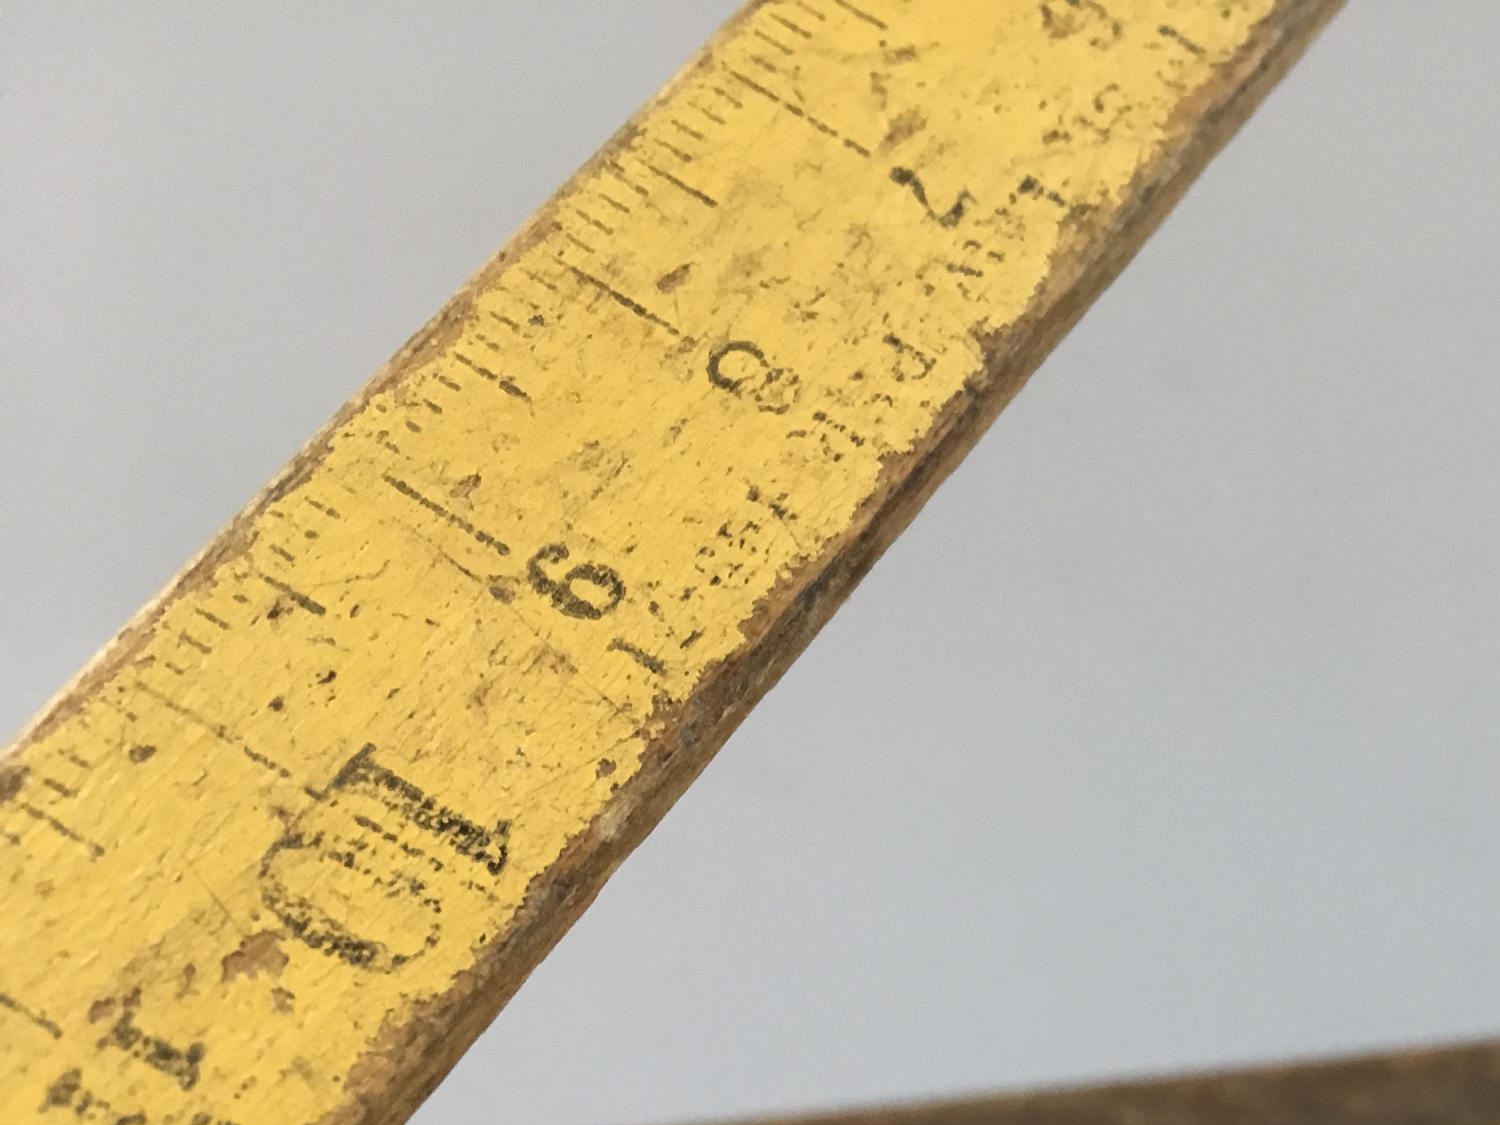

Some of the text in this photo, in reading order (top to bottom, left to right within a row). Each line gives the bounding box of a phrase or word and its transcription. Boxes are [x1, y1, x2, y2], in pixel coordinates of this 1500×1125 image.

[890, 165, 975, 228] 7
[707, 341, 799, 414] 8
[260, 742, 510, 971] 10
